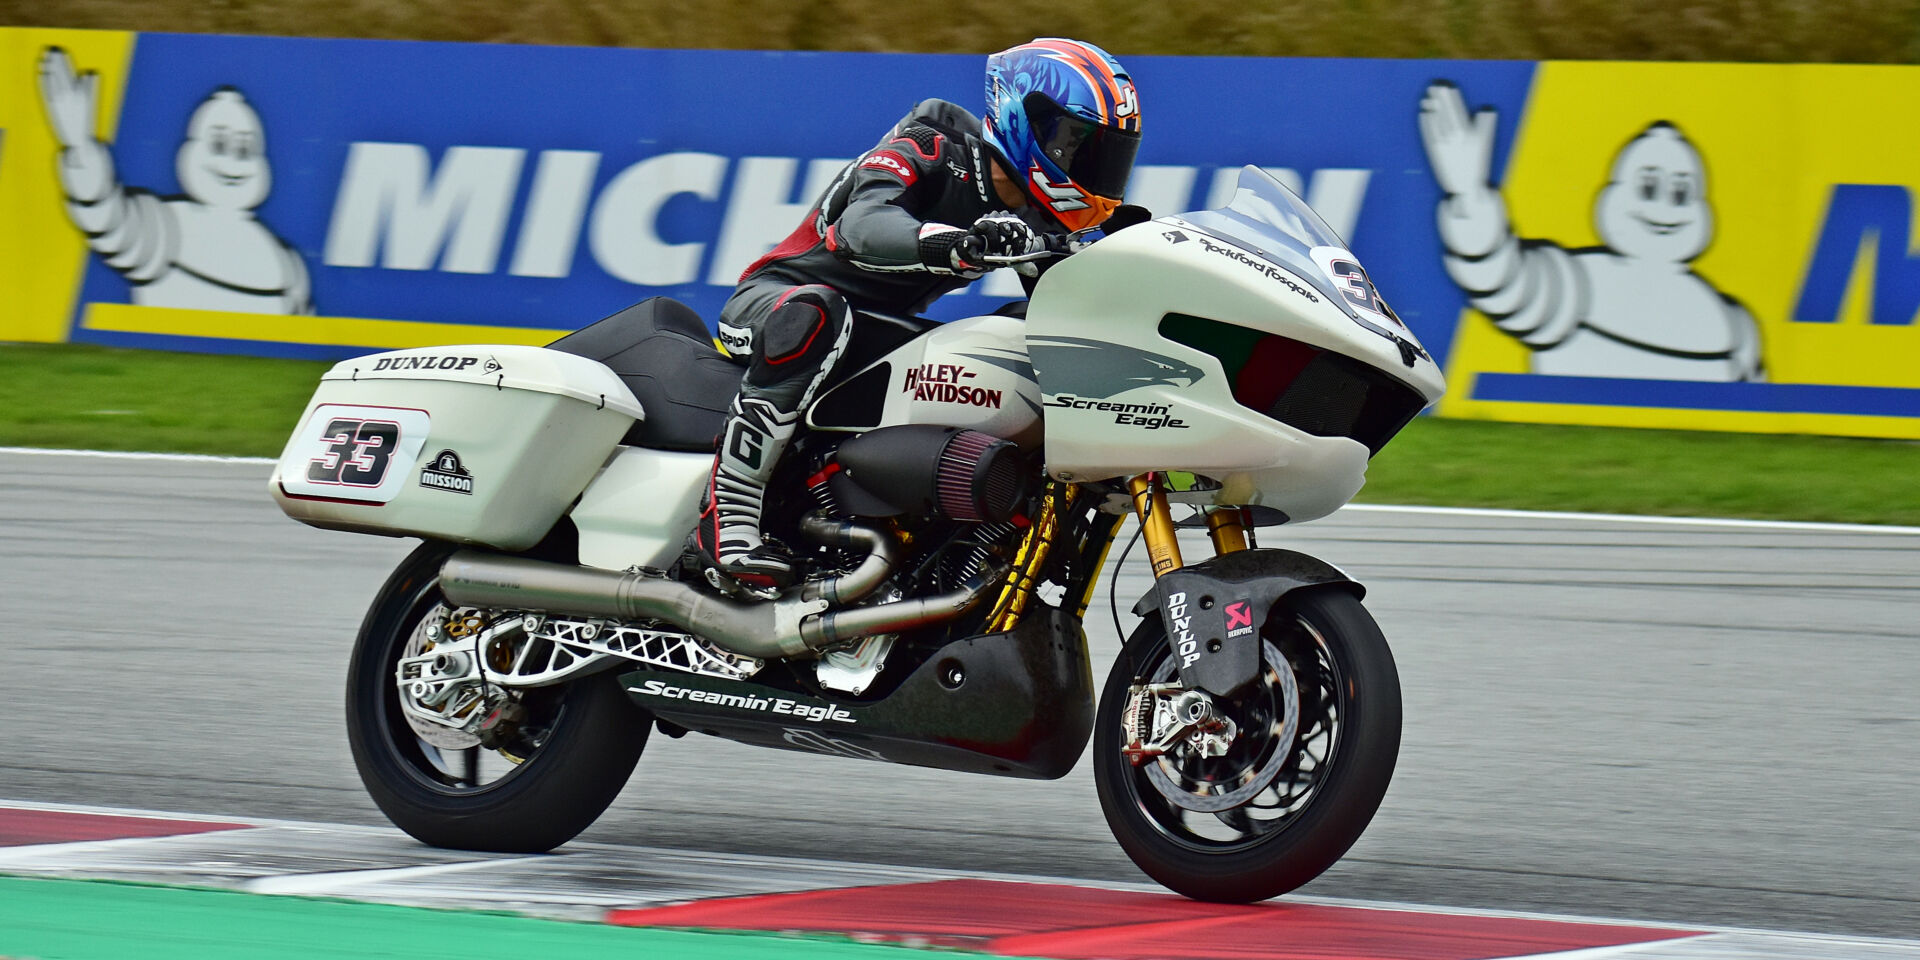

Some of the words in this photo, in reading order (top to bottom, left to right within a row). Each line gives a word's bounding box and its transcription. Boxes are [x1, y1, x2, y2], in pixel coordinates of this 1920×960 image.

[721, 332, 749, 348] SPIDI
[373, 357, 478, 371] DUNLOP
[913, 382, 1003, 410] AVIDSON
[1043, 396, 1172, 416] Screamin'
[1115, 413, 1190, 430] Eagle
[305, 417, 401, 488] 33
[1168, 592, 1200, 670] DUNLOP
[772, 698, 857, 722] Eagle
[1130, 700, 1139, 733] brembo
